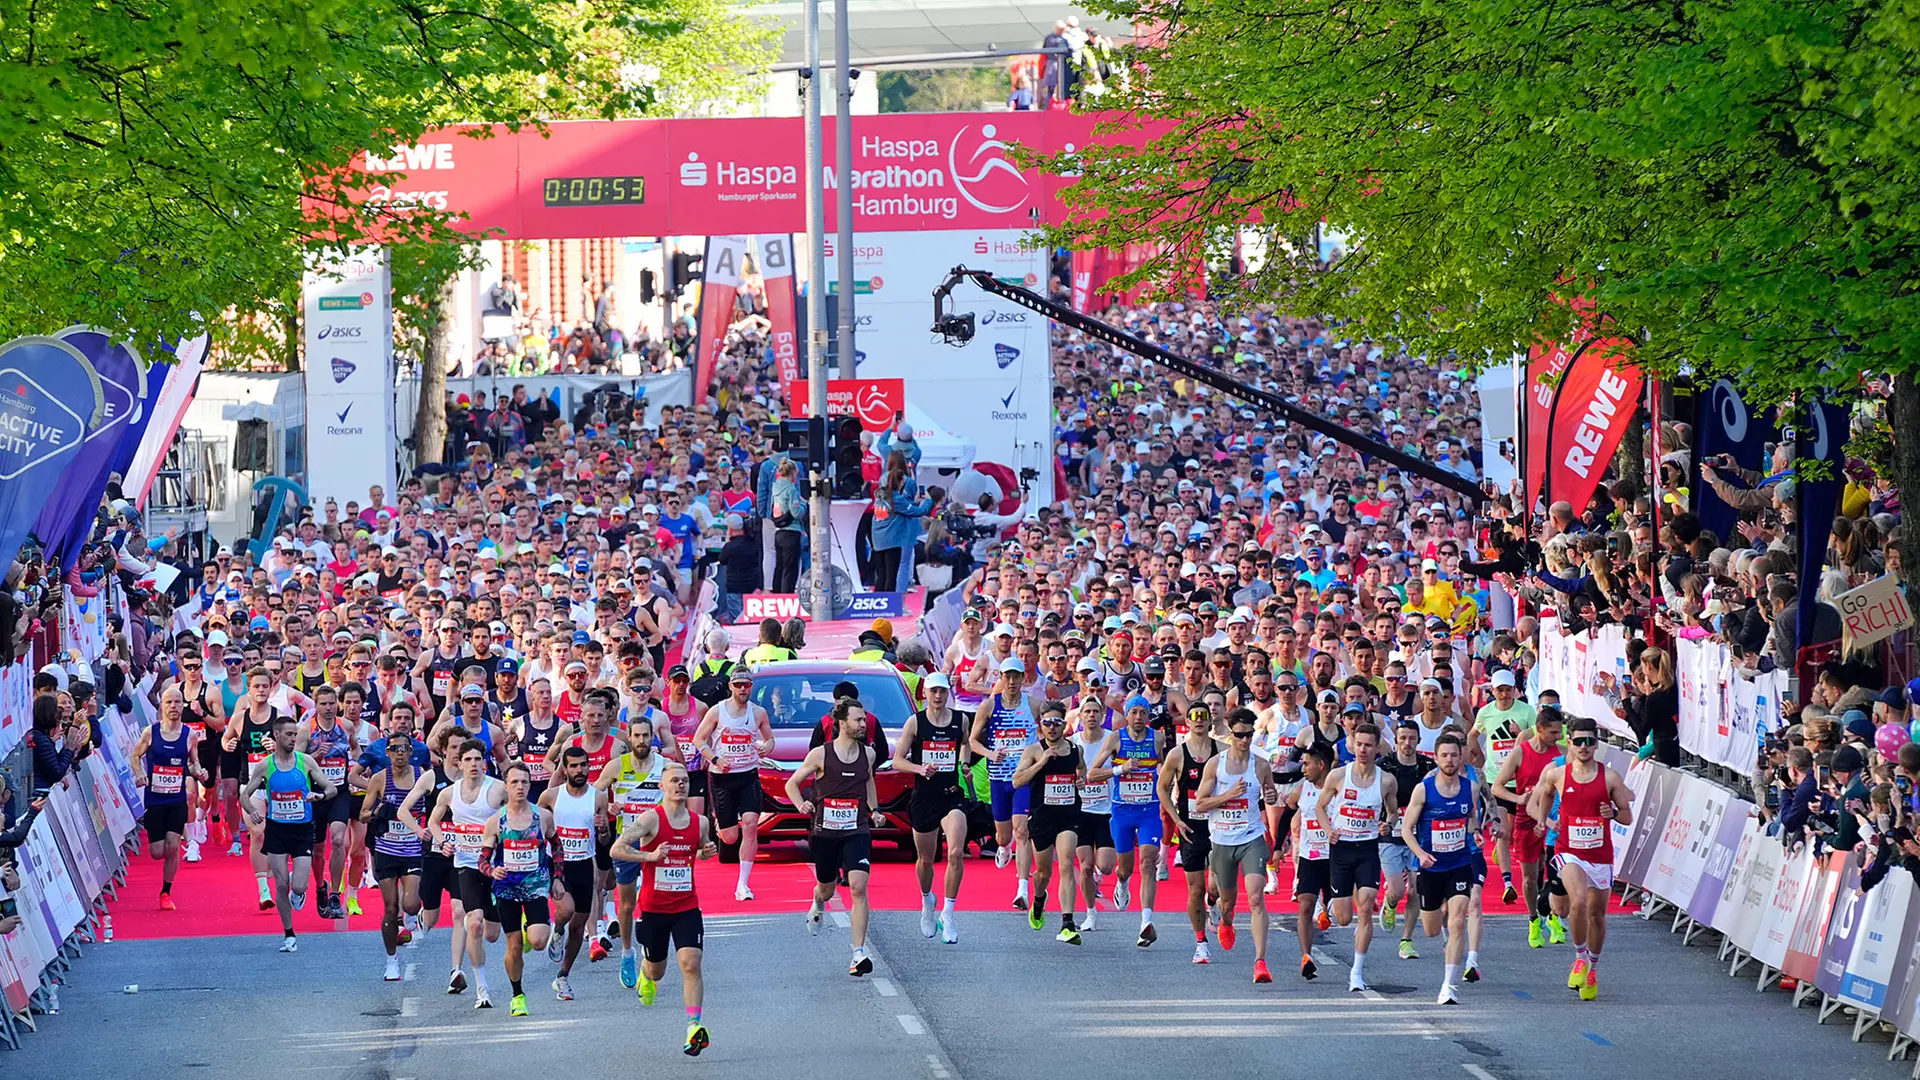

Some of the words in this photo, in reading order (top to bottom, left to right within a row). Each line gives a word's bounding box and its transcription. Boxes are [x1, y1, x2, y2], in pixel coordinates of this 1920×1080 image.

[862, 136, 940, 161] Haspa
[717, 161, 797, 189] Haspa
[545, 177, 644, 202] 0:00:53
[718, 192, 759, 202] Hamburger
[761, 191, 797, 201] Sparkasse
[852, 246, 884, 259] aspa
[715, 247, 736, 276] A
[827, 391, 853, 402] aspa
[0, 393, 37, 415] Hamburg
[992, 411, 1027, 421] Rexona
[0, 411, 64, 445] ACTIVE
[1564, 368, 1628, 479] REWE
[327, 425, 363, 435] Rexona
[0, 433, 37, 457] CITY
[1001, 739, 1021, 747] 1230
[727, 745, 746, 753] 1053
[929, 752, 950, 760] 1104
[321, 768, 340, 776] 1106
[158, 776, 177, 784] 1063
[1052, 785, 1071, 793] 1021
[1127, 782, 1148, 791] 1112
[831, 810, 852, 818] 1083
[1220, 810, 1241, 819] 1012
[1346, 819, 1367, 828] 1008
[1439, 830, 1460, 839] 1010
[1576, 828, 1597, 836] 1024
[463, 835, 482, 843] 1261
[562, 840, 581, 848] 1001
[511, 851, 532, 860] 1043
[663, 869, 686, 878] 1460
